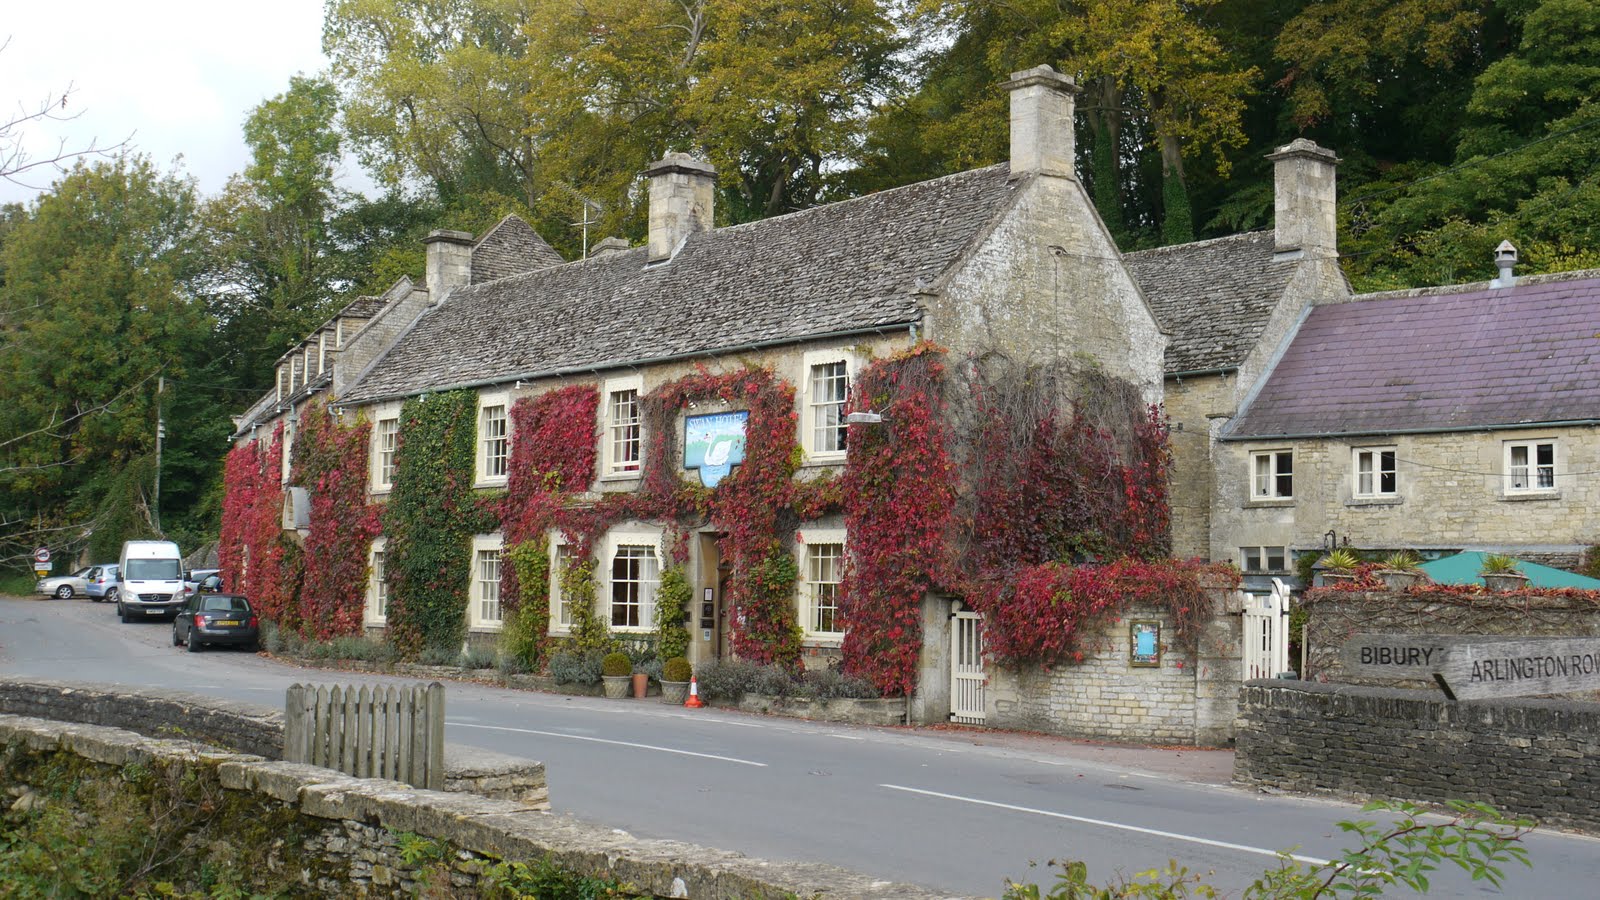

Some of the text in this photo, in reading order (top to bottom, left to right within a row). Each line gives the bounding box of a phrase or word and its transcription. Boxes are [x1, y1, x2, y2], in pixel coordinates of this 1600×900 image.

[689, 413, 743, 428] SWAN HOTEL
[1361, 646, 1433, 666] BIBURY
[1470, 655, 1568, 682] ARLINGTON
